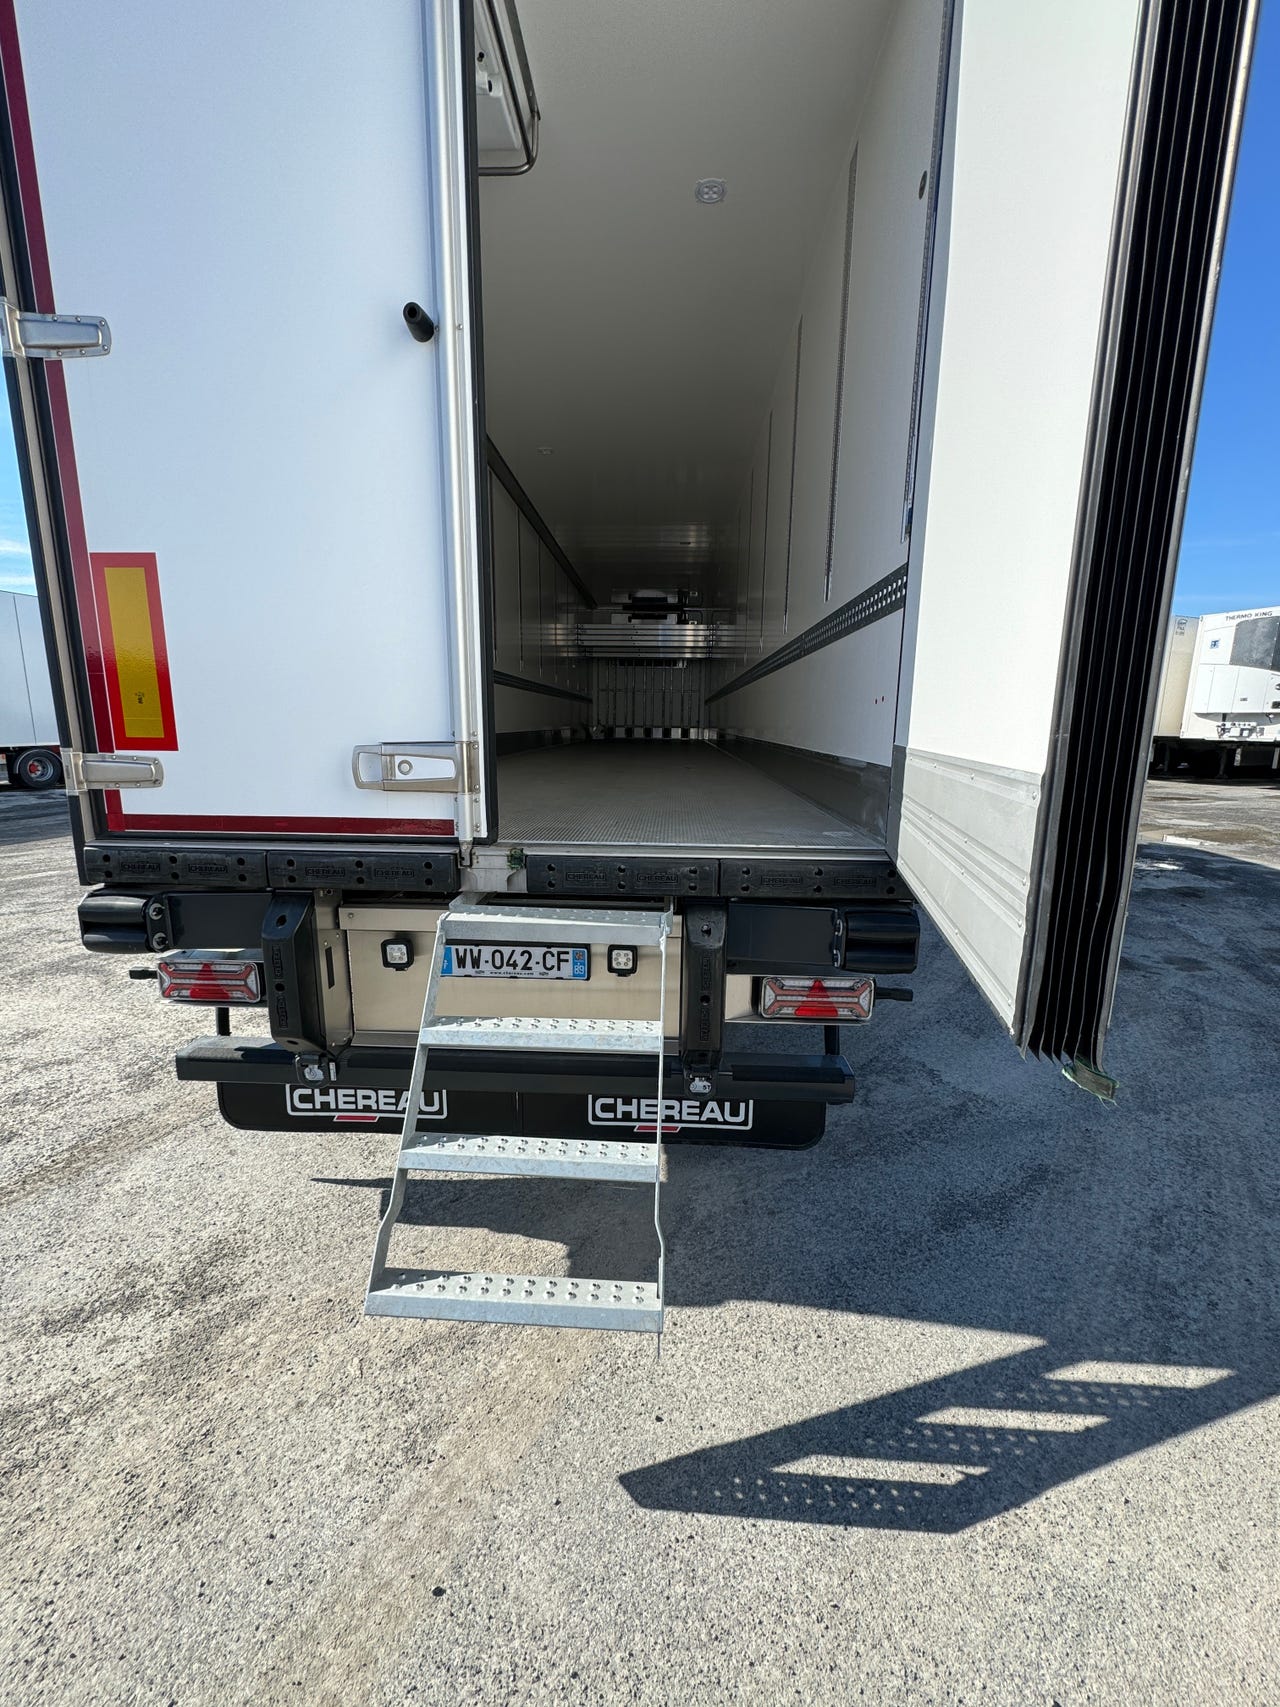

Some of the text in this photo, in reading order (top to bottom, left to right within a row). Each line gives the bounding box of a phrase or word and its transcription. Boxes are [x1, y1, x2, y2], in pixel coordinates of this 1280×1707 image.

[1226, 613, 1252, 621] THERMO
[566, 872, 606, 881] CHEREAU
[638, 873, 677, 883] CHEREAU
[455, 948, 570, 971] WW-042-CF
[574, 965, 585, 975] 89
[595, 1097, 746, 1123] CHEREAU
